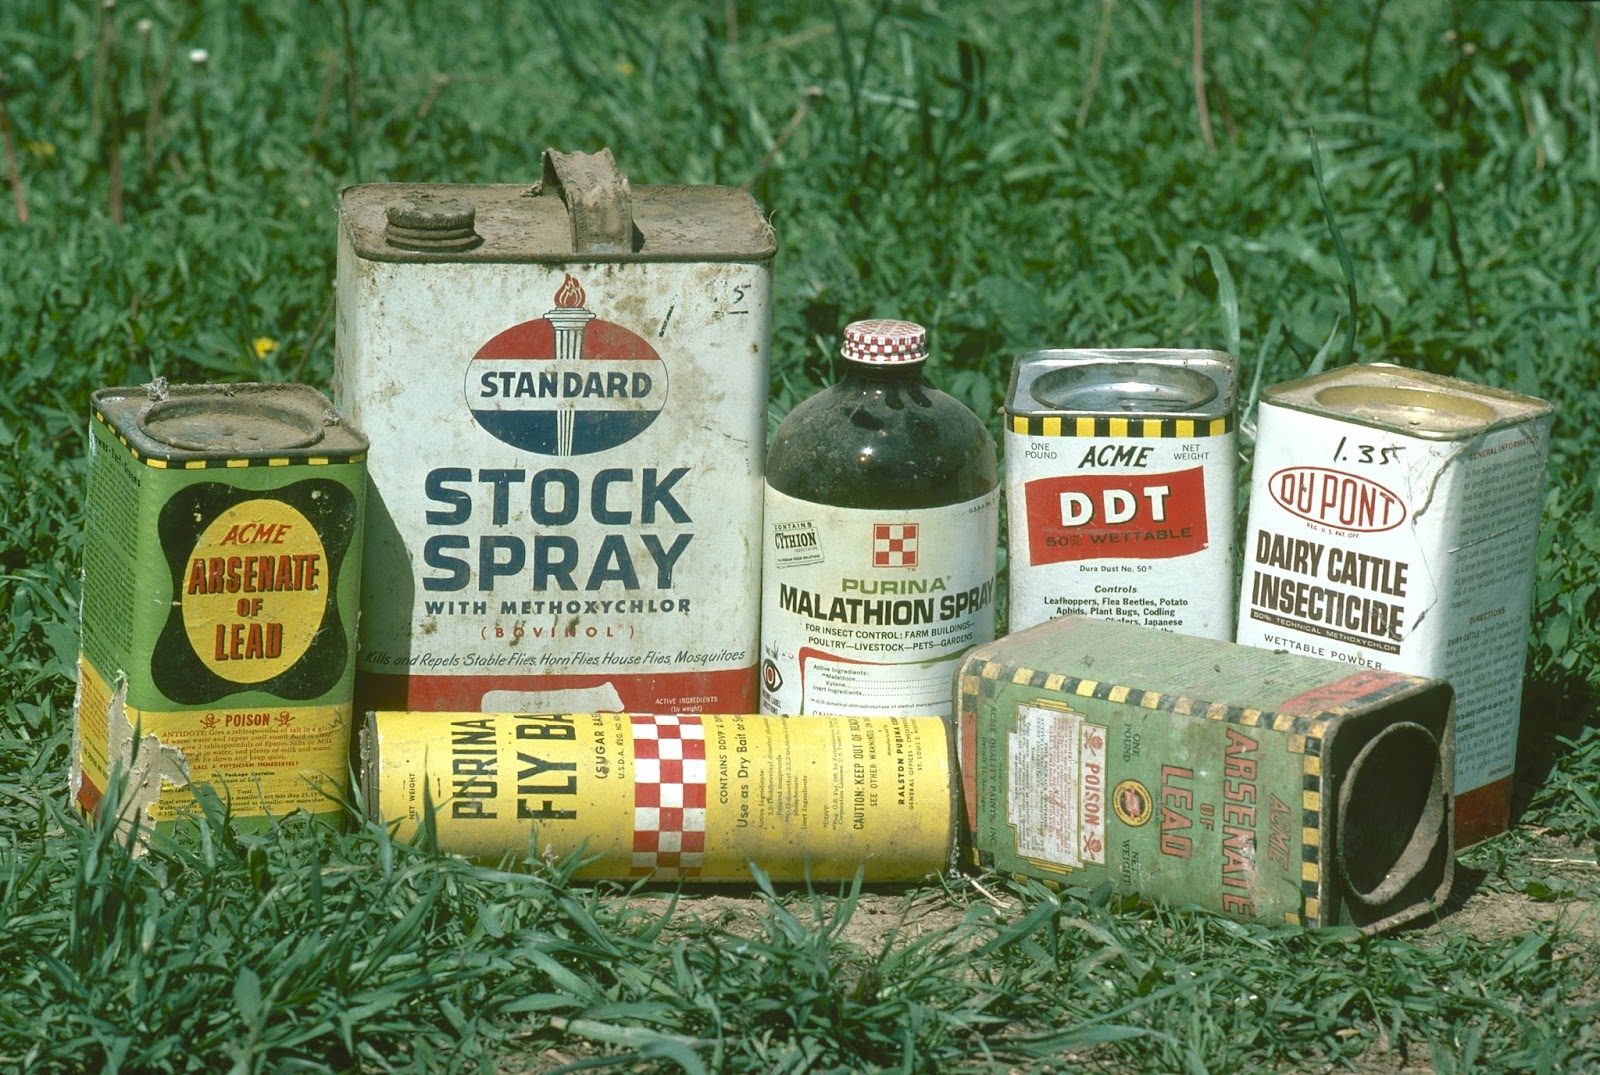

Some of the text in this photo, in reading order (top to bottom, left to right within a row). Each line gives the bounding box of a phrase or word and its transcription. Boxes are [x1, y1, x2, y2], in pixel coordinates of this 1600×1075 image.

[480, 371, 652, 398] STANDARD
[1025, 451, 1057, 460] POUND
[1078, 445, 1154, 468] ACME
[1174, 452, 1210, 460] WEIGHT
[1334, 436, 1406, 464] 1.35
[1469, 448, 1497, 461] GENERAL
[424, 467, 693, 526] STOCK
[1060, 485, 1170, 527] DDT
[1281, 472, 1395, 526] DU PONT
[219, 523, 292, 546] ACME
[774, 521, 812, 531] CONTAINS
[1046, 527, 1192, 547] 50% WETTABLE
[422, 533, 694, 592] SPRAY
[1256, 529, 1324, 577] DAIRY
[1328, 548, 1408, 598] CATTLE
[187, 554, 320, 596] ARSENATE
[780, 576, 994, 625] MALATHION SPRAY
[1095, 585, 1137, 593] Controls
[237, 598, 263, 617] OF
[425, 599, 691, 615] WITH METHOXYCHLOR
[1044, 597, 1099, 606] Leafhoppers,
[1123, 598, 1157, 606] Beetles,
[1056, 607, 1087, 615] Aphids,
[1116, 608, 1140, 616] Bugs,
[1144, 608, 1175, 616] Codling
[1252, 571, 1404, 641] INSECTICIDE
[1144, 618, 1183, 626] Japanese
[1469, 607, 1505, 625] DIRECTIONS
[214, 623, 283, 661] LEAD
[805, 623, 820, 632] FOR
[822, 627, 853, 638] INSECT
[856, 630, 902, 640] CONTROL:
[905, 629, 929, 639] FARM
[1254, 612, 1397, 652] 50% TECHNICAL METHOXYCHLOR
[365, 651, 391, 665] Kills
[394, 655, 419, 665] and
[420, 653, 459, 669] Repels
[463, 653, 505, 666] Stable
[508, 652, 537, 666] Flies,
[540, 653, 569, 665] Horn
[602, 652, 641, 664] House
[643, 651, 672, 665] Flies,
[675, 649, 745, 666] Mosquitoes
[1264, 634, 1382, 670] WETTABLE POWDER
[813, 664, 869, 677] Active Ingredients:
[679, 696, 718, 704] INGREDIENTS
[827, 688, 862, 696] Ingredients
[225, 714, 270, 727] POISON
[989, 706, 997, 733] ACME
[616, 732, 624, 746] REG.
[735, 734, 747, 752] Bait
[867, 730, 876, 760] WARNINGS
[894, 727, 903, 754] PURINA
[1123, 723, 1131, 762] POUND
[1132, 734, 1141, 757] ONE
[595, 730, 606, 779] (SUGAR
[853, 744, 863, 759] OUT
[450, 719, 497, 820] PURINA
[718, 731, 728, 804] CONTAINS DDVP
[737, 757, 750, 778] Dry
[854, 763, 864, 784] KEEP
[870, 764, 878, 788] OTHER
[517, 751, 577, 820] FLY
[740, 784, 748, 798] as
[1085, 762, 1100, 826] POISON
[853, 787, 864, 830] CAUTION:
[988, 785, 996, 822] PAINTS,
[1160, 764, 1193, 859] LEAD
[737, 804, 748, 827] Use
[1200, 804, 1214, 830] OF
[1222, 728, 1258, 918] ARSENATE
[1122, 840, 1131, 885] WEIGHT
[1131, 851, 1139, 874] NET
